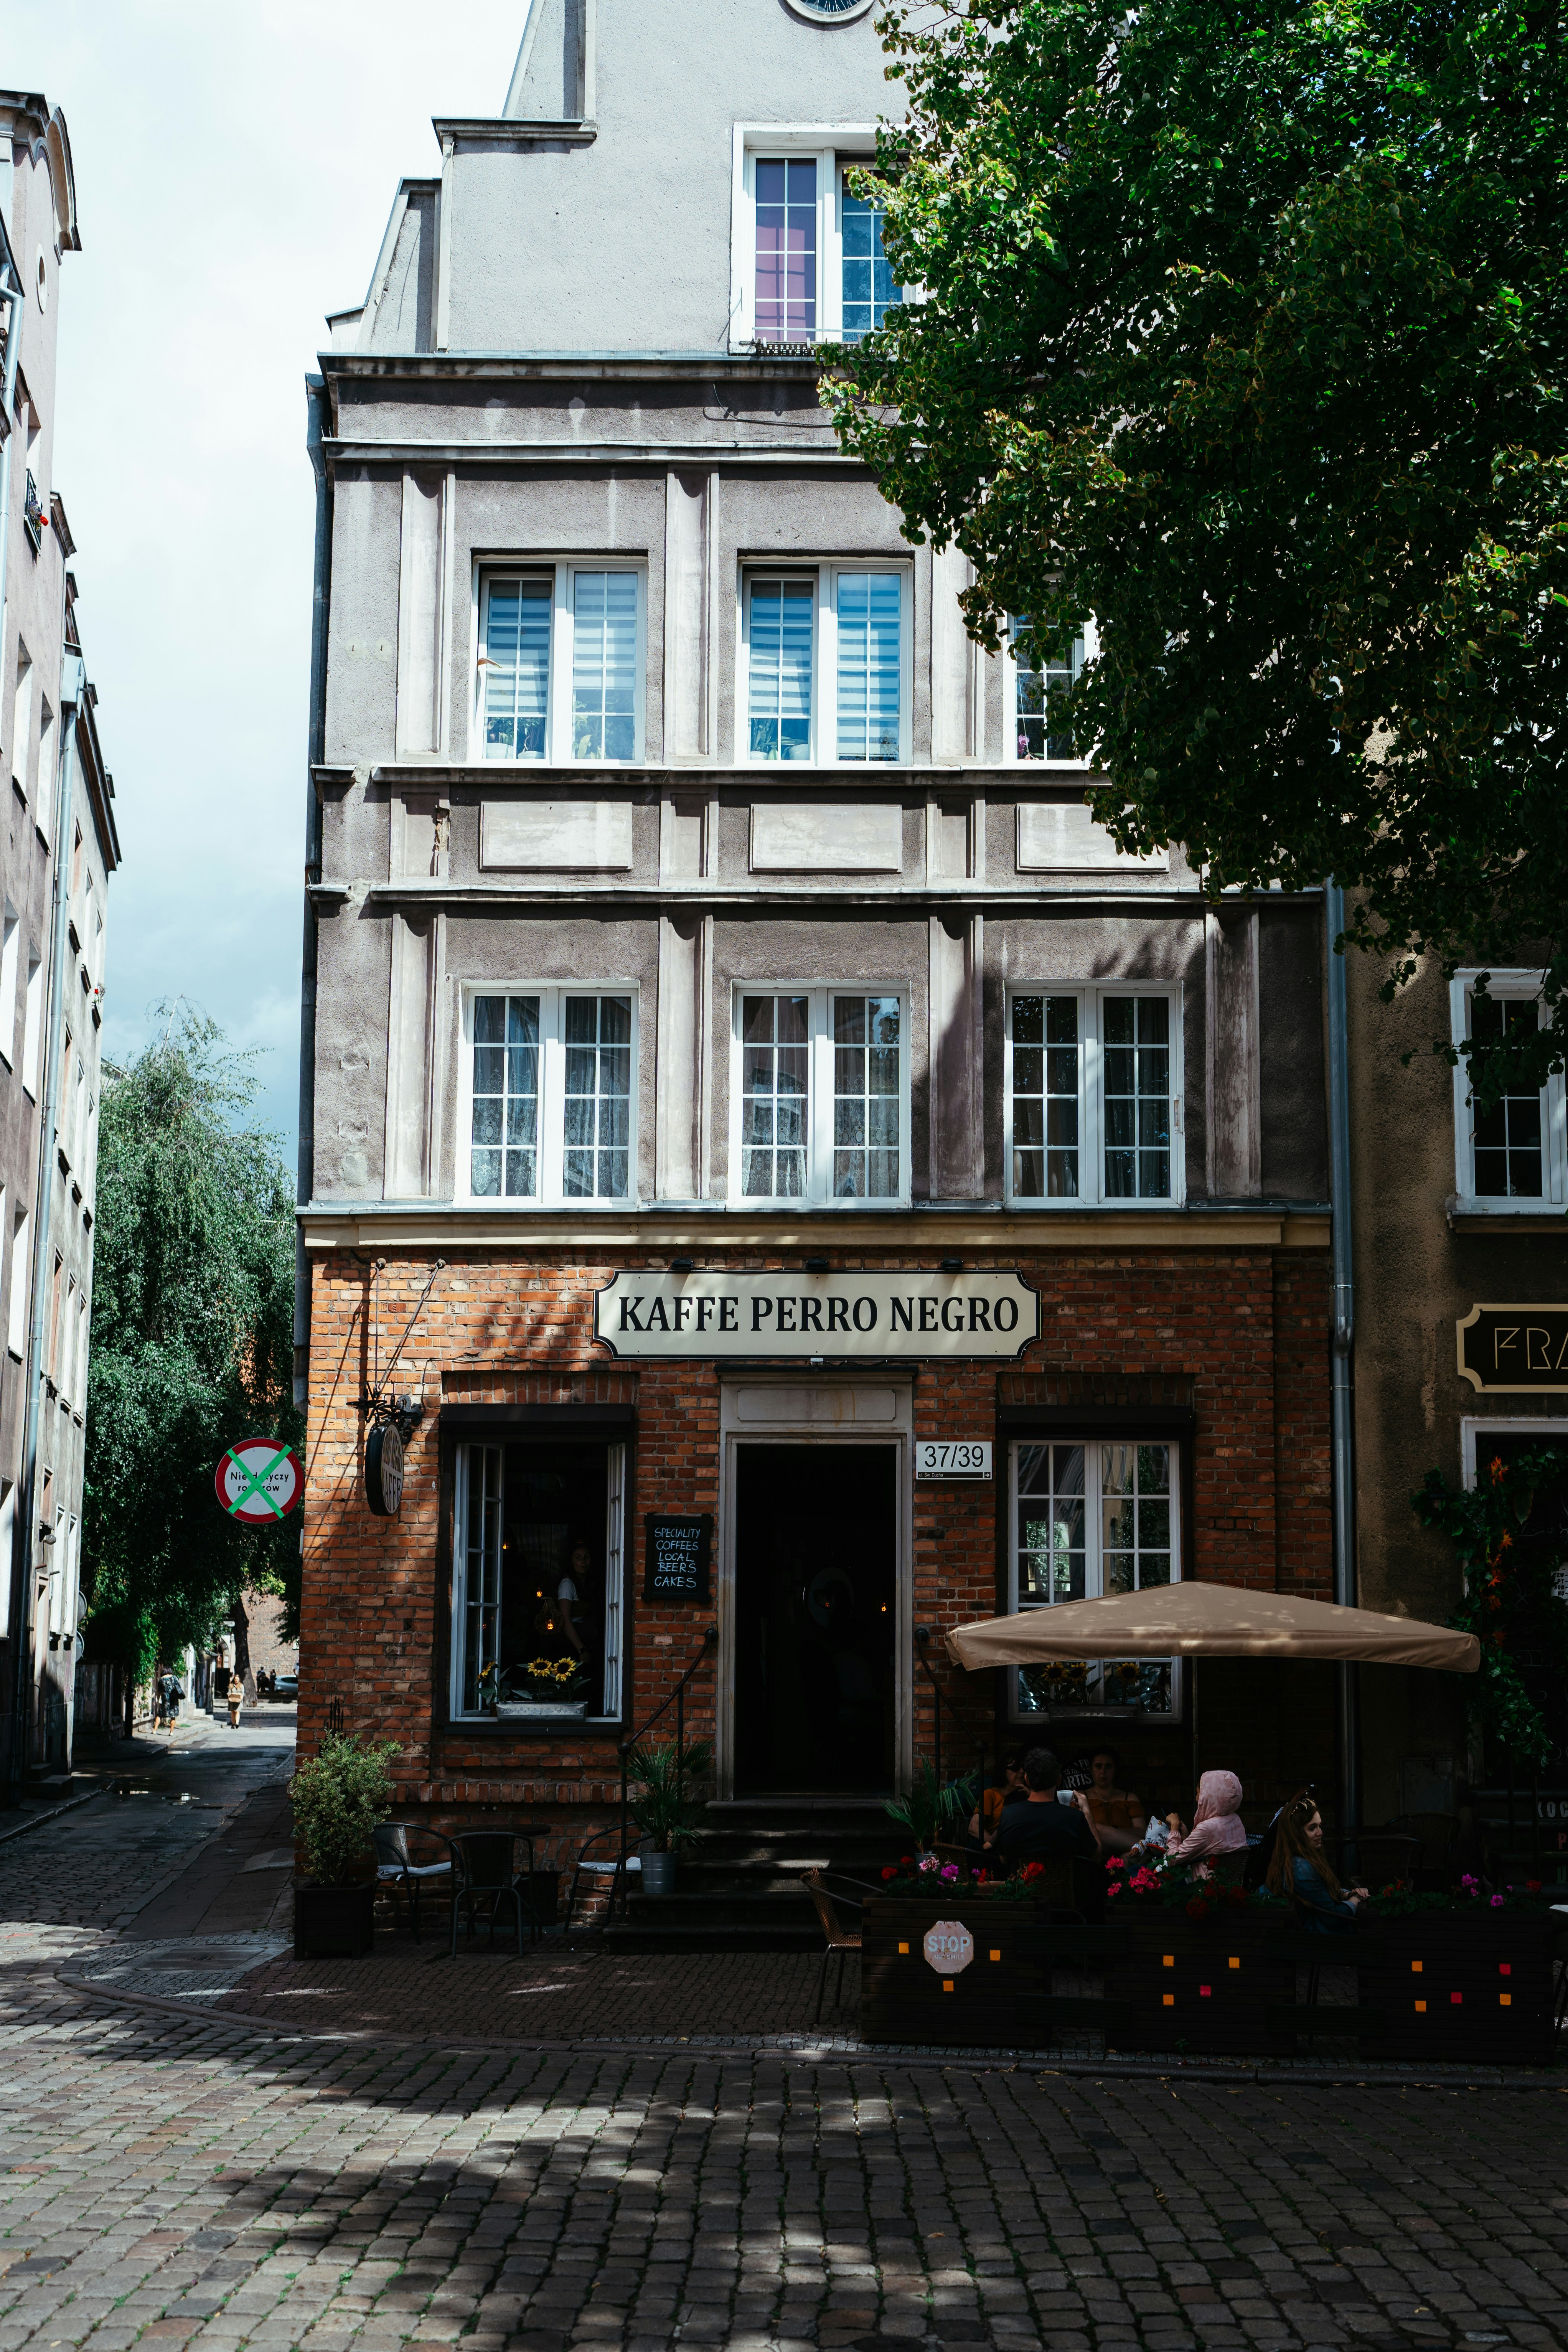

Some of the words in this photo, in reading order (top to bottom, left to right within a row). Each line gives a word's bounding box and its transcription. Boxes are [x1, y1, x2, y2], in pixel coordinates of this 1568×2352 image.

[618, 1296, 739, 1331] KAFFE
[750, 1296, 878, 1332] PERRO
[890, 1296, 1019, 1332] NEGRO
[925, 1445, 984, 1468] 37/39
[231, 1472, 247, 1480] Nie
[252, 1472, 289, 1482] dyczy
[238, 1483, 280, 1491] rorów
[656, 1540, 699, 1550] COFFEES
[659, 1552, 694, 1562] LOCAL
[657, 1562, 697, 1573] BEERS
[655, 1576, 697, 1588] CAKES
[928, 1936, 970, 1952] STOP
